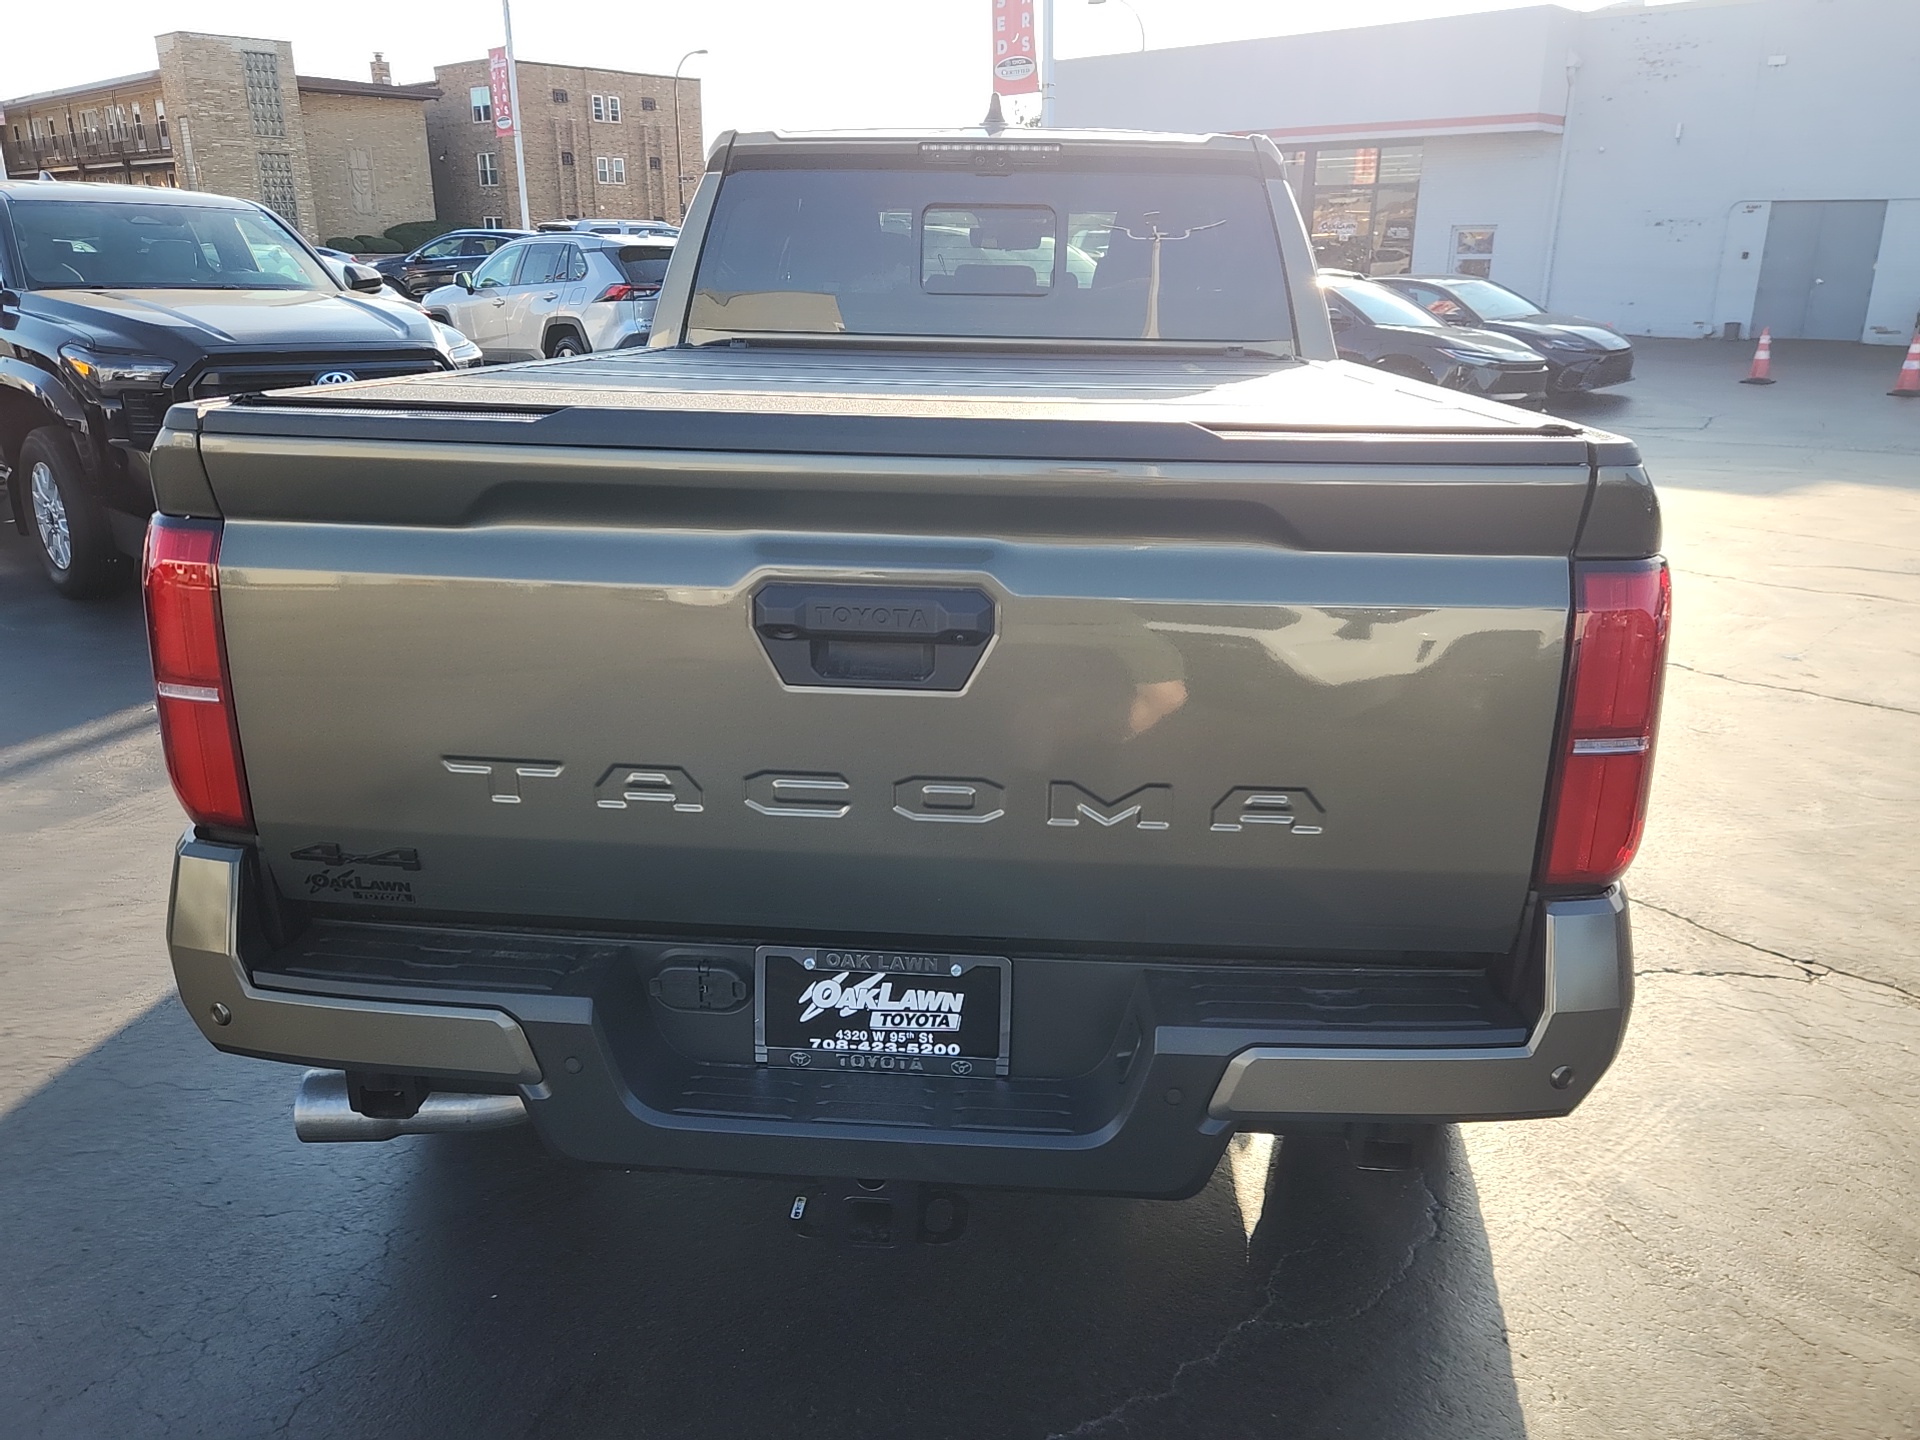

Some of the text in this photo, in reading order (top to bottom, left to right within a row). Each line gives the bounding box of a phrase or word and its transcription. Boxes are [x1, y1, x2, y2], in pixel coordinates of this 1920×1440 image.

[996, 0, 1007, 55] ED
[815, 605, 928, 628] TOYOTA
[440, 754, 1328, 835] TACOMA
[360, 892, 410, 902] TOYOTA
[826, 953, 939, 972] OAK LAWN
[880, 1012, 951, 1027] TOYOTA
[835, 1029, 934, 1044] 4320 W 95th St
[809, 1037, 961, 1056] 708-423-5200
[835, 1053, 924, 1071] TOYOTA
